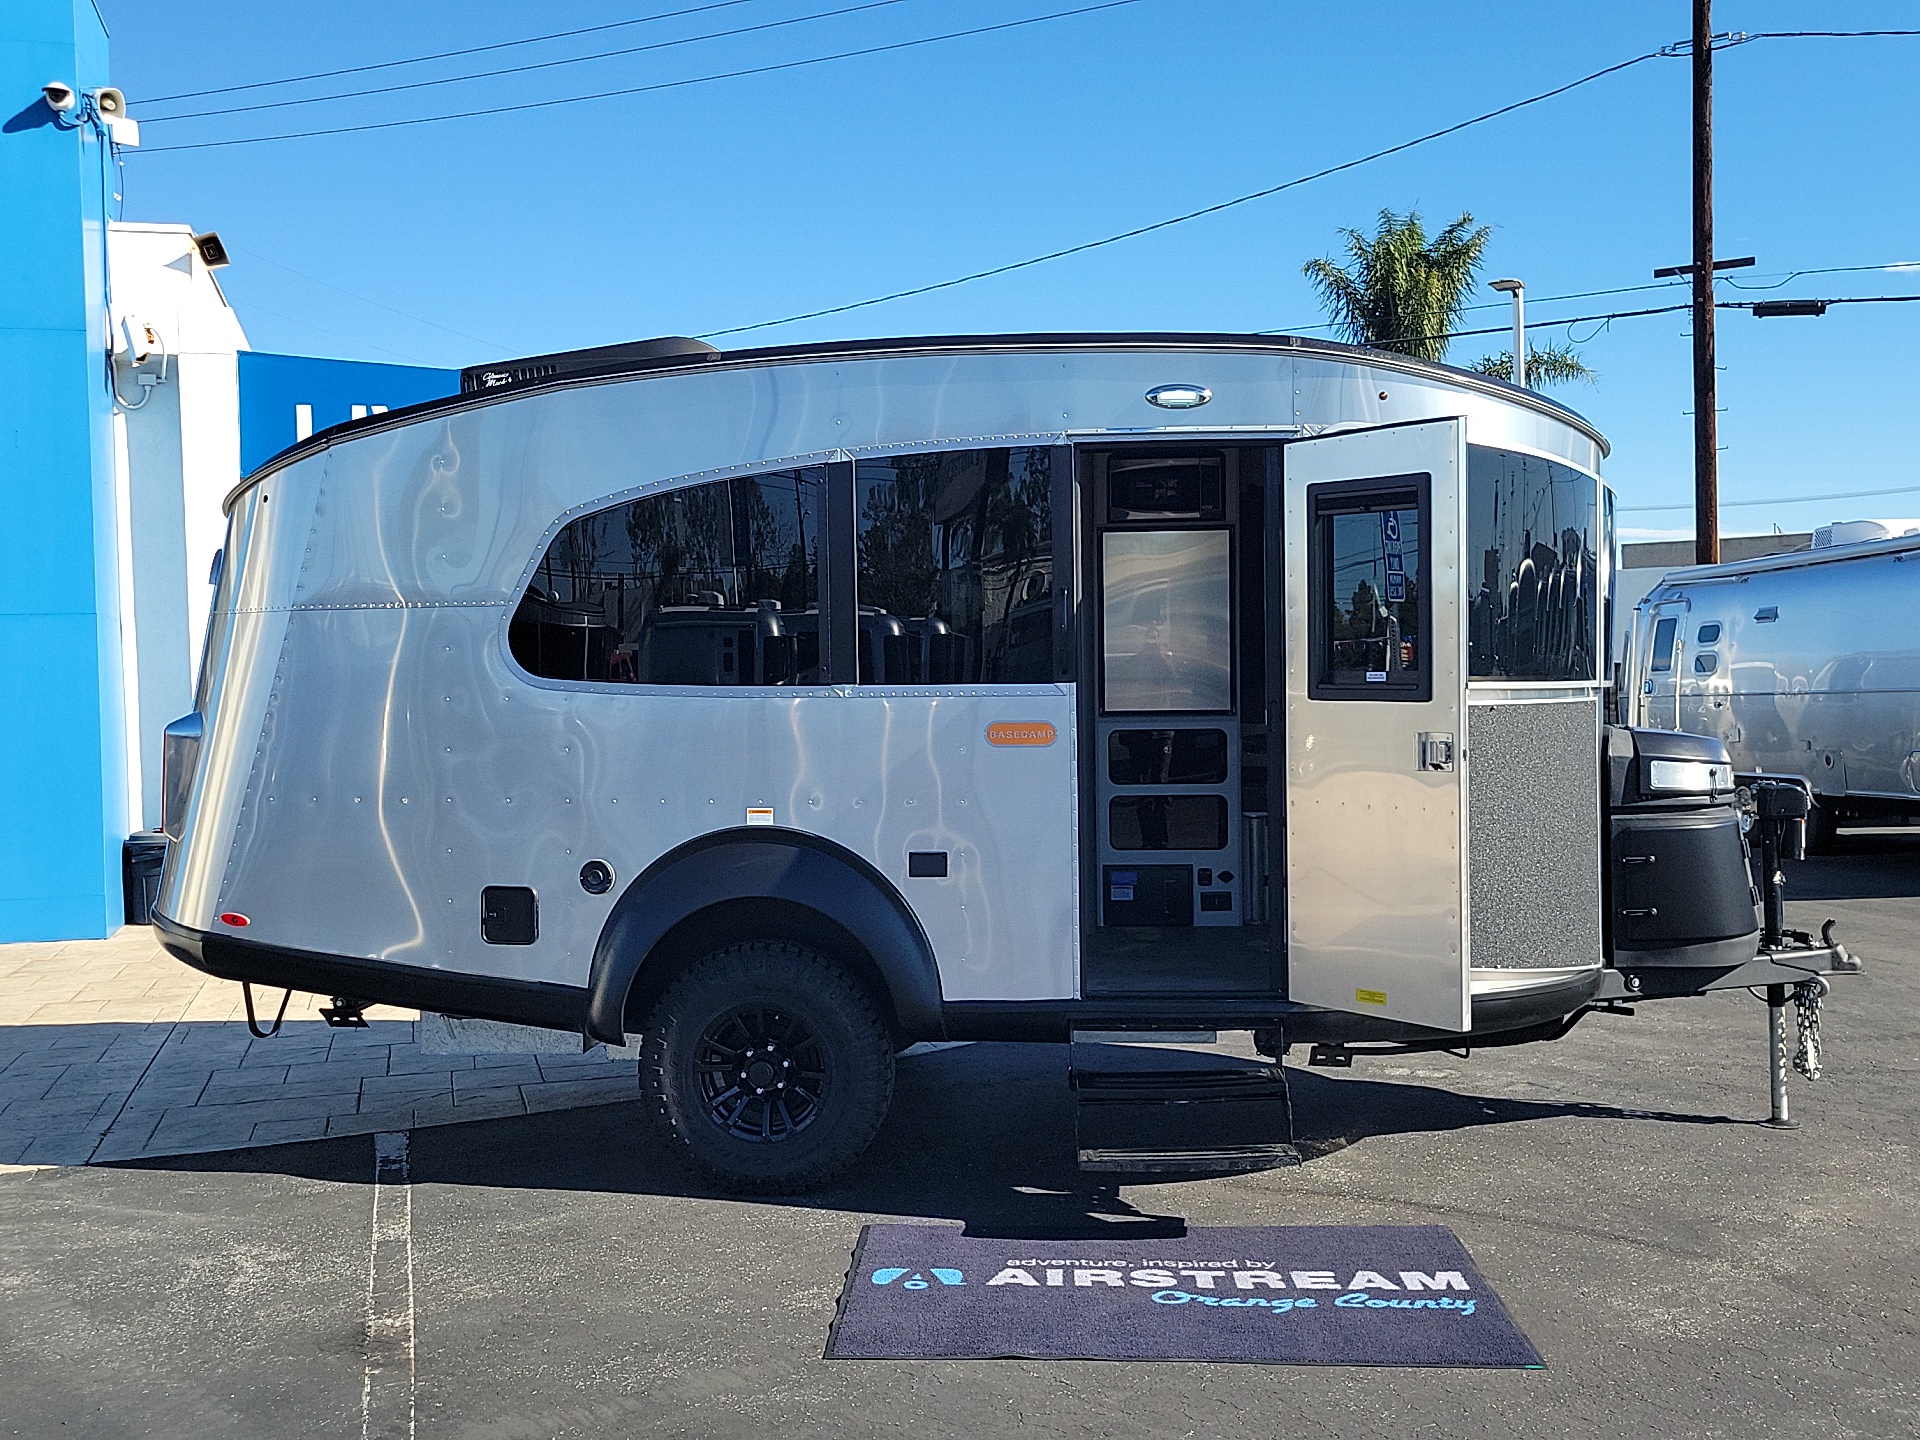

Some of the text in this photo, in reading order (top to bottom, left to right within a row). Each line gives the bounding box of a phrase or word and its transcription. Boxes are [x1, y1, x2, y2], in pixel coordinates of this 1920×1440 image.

[989, 730, 1055, 739] BASECAMP
[1006, 1258, 1277, 1269] adventure, inspired by
[985, 1268, 1471, 1291] AIRSTREAM
[1151, 1290, 1476, 1315] Orange County
